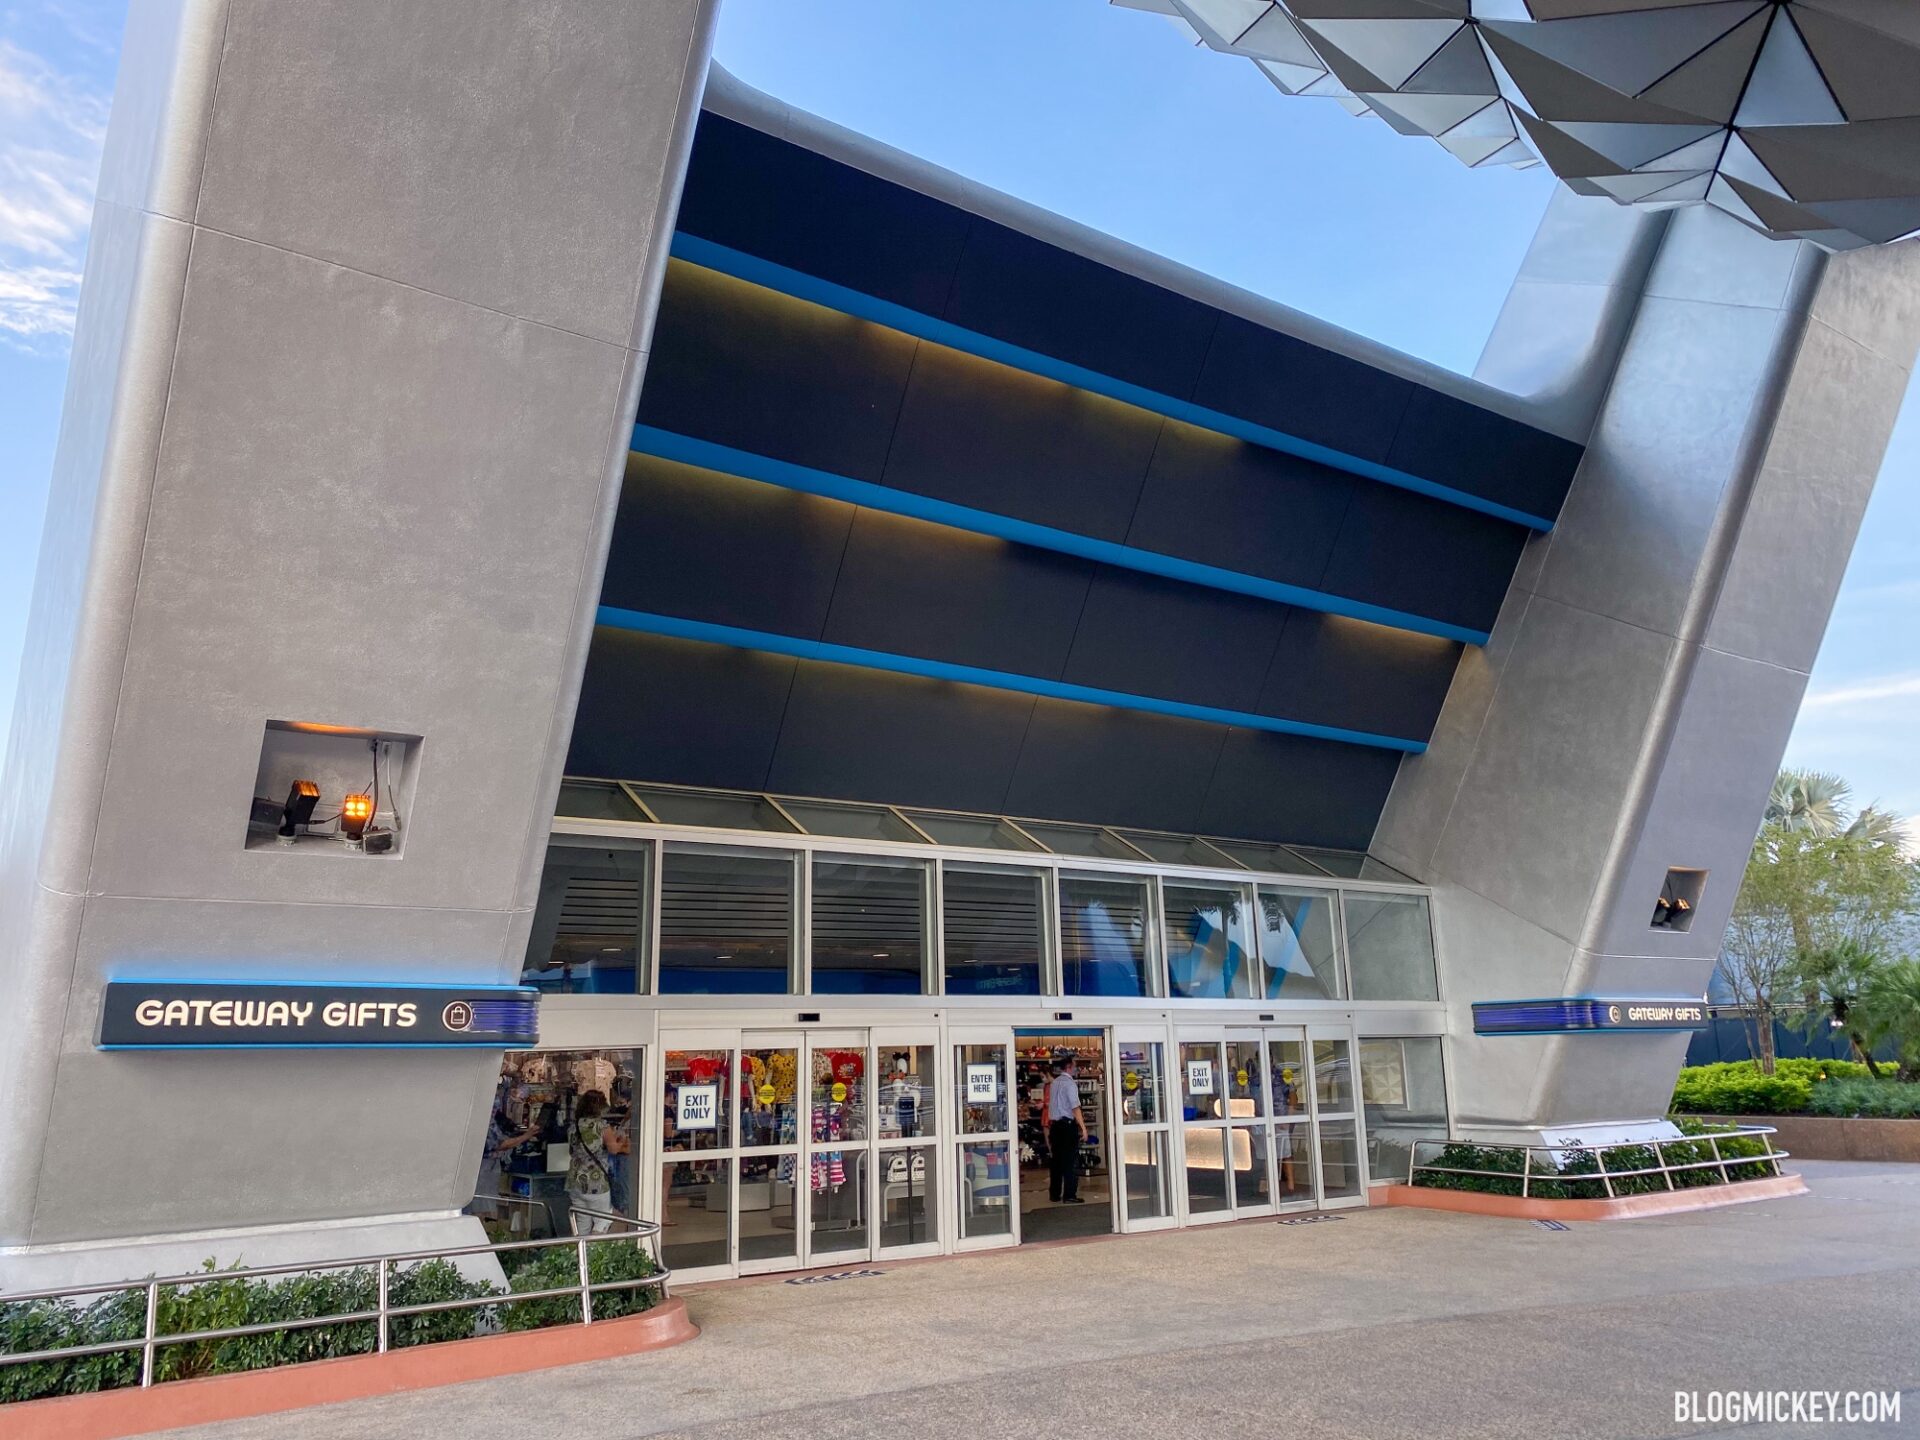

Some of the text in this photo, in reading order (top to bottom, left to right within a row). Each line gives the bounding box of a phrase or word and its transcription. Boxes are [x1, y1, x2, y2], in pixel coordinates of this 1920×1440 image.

[135, 1000, 417, 1027] GATEWAY GIFTS
[1628, 1007, 1701, 1020] GATEWAY GIFTS
[1192, 1068, 1207, 1077] EXIT
[971, 1075, 993, 1083] ENTER
[1192, 1078, 1209, 1087] ONLY
[973, 1084, 990, 1093] HERE
[685, 1095, 709, 1106] EXIT
[683, 1107, 710, 1119] ONLY
